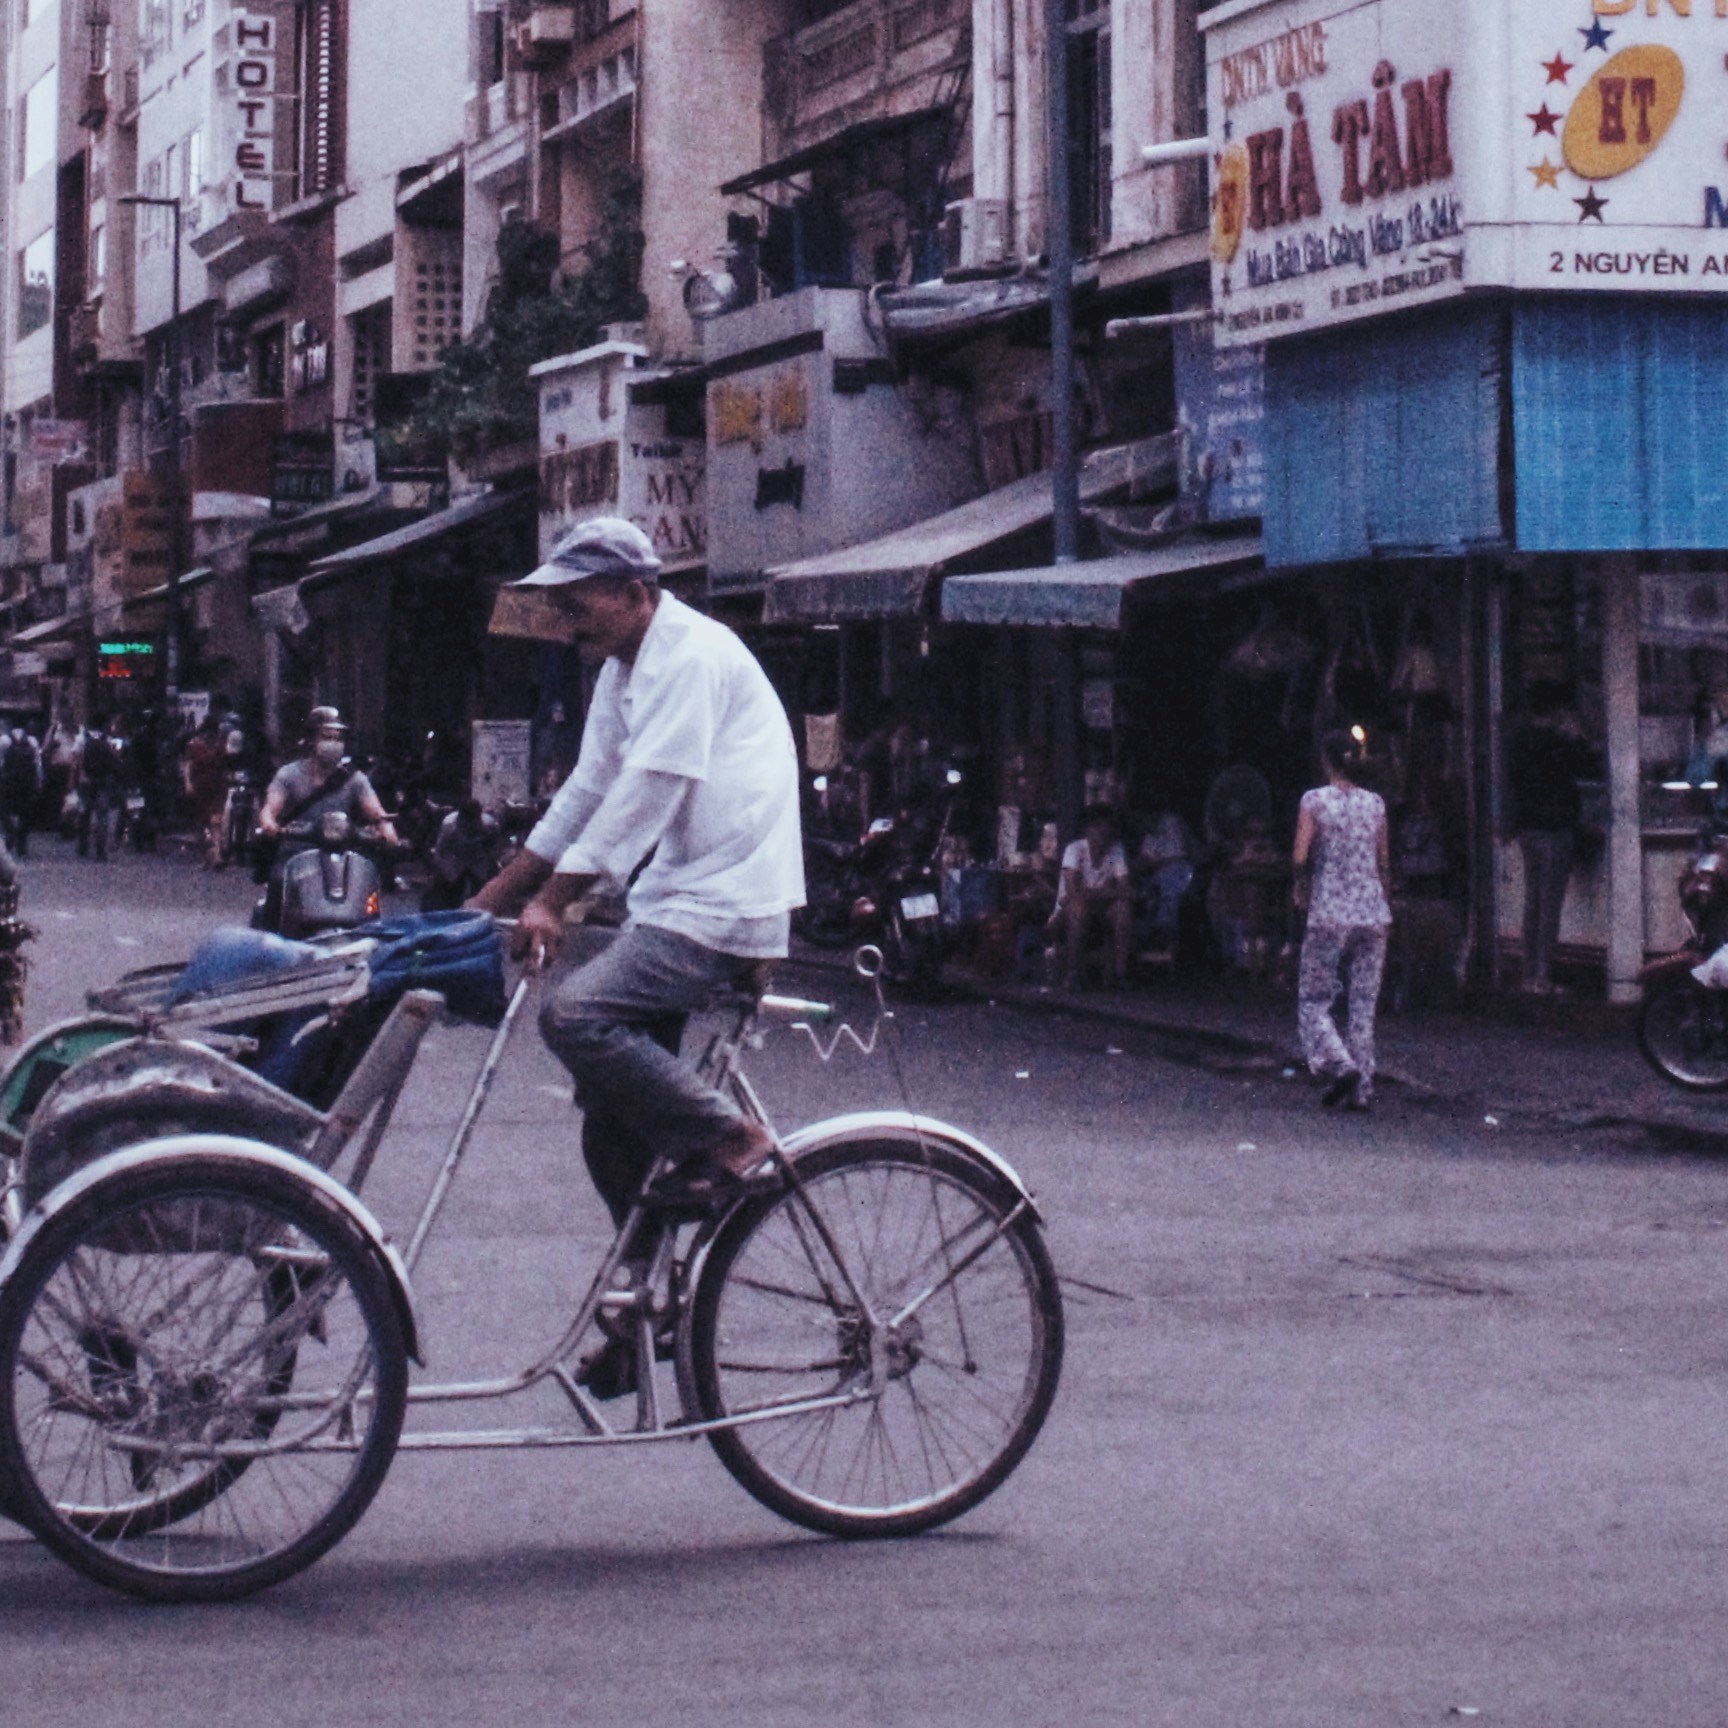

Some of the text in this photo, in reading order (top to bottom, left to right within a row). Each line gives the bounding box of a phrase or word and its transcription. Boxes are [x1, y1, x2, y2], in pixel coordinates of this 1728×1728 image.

[236, 20, 269, 210] HOTEL
[1247, 59, 1453, 230] HÀ TÂM
[1596, 78, 1657, 145] HT
[1550, 252, 1563, 273] 2
